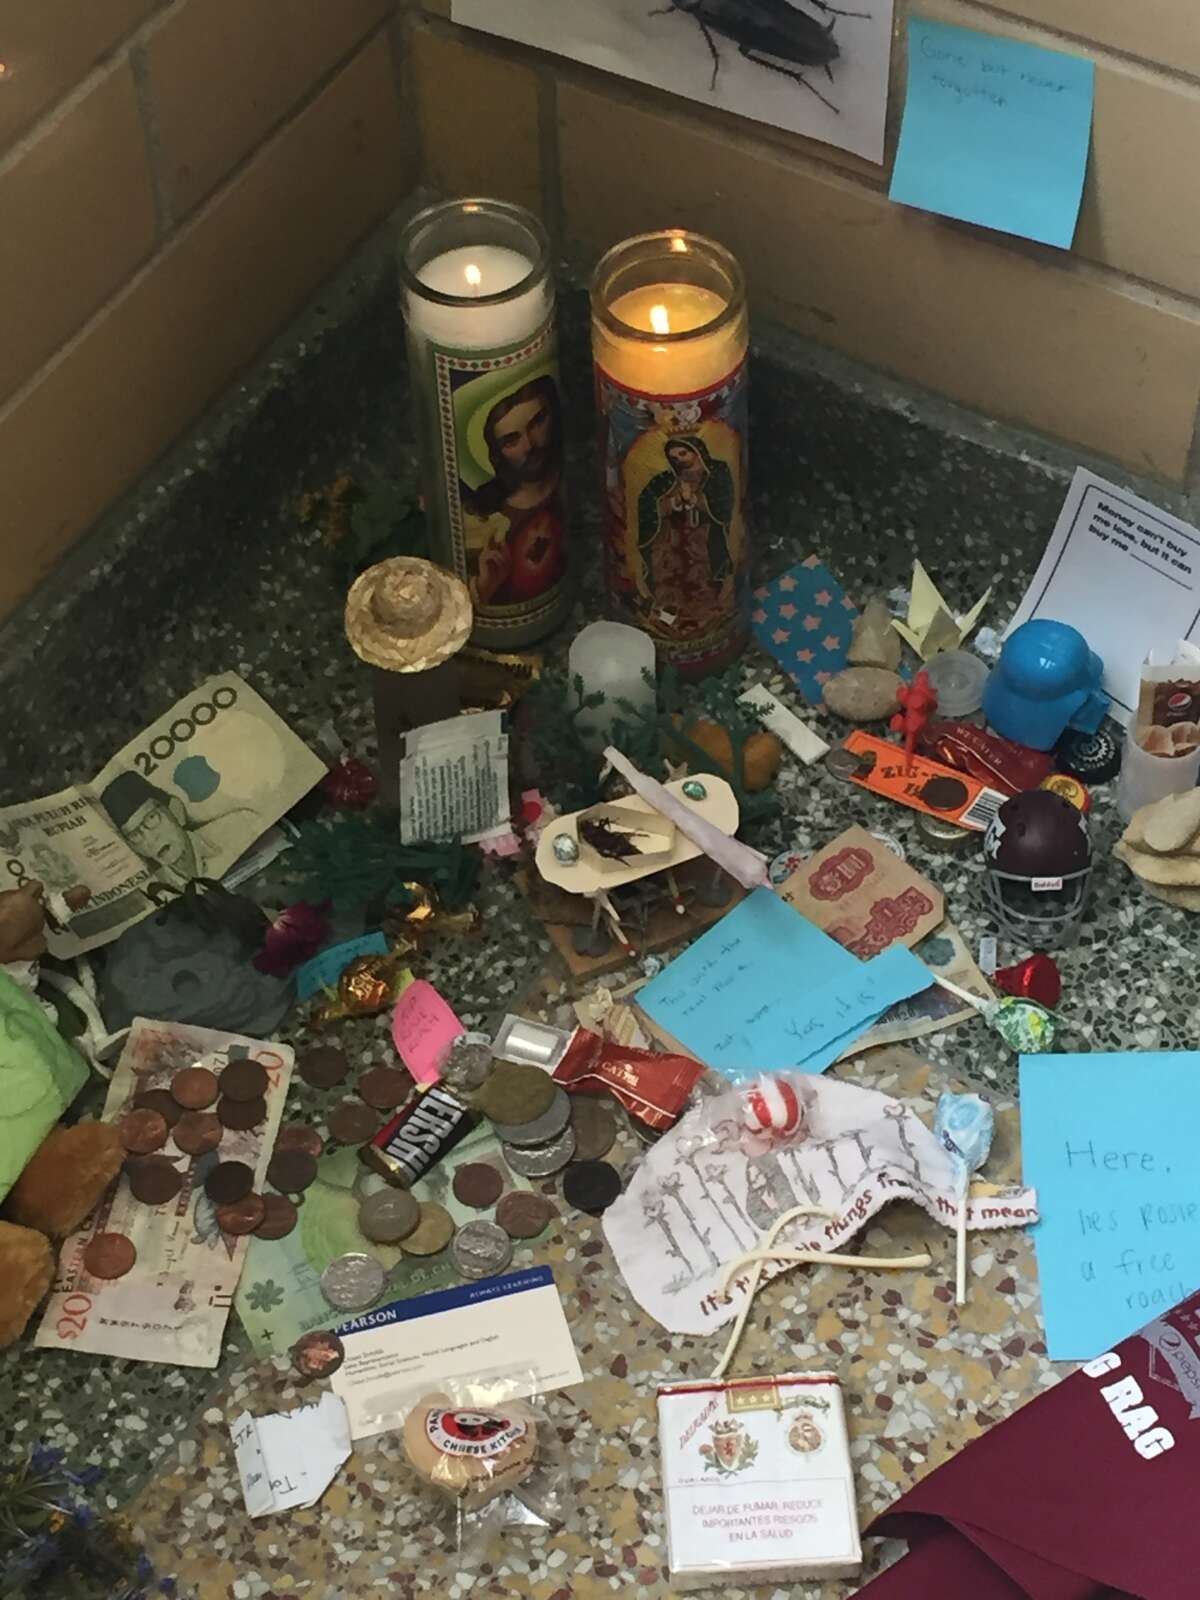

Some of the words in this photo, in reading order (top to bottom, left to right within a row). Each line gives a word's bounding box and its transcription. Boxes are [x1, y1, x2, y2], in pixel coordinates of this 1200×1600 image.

[1088, 524, 1110, 541] buy
[1111, 538, 1129, 551] me
[1093, 514, 1111, 527] me
[1113, 524, 1138, 544] love,
[1140, 539, 1160, 555] but
[1161, 551, 1169, 561] it
[1171, 558, 1192, 574] can
[1097, 502, 1135, 528] Money
[1136, 525, 1165, 544] can't
[1166, 541, 1188, 557] buy
[134, 686, 238, 777] 20000
[824, 1188, 873, 1241] things
[935, 1195, 974, 1220] tht
[981, 1206, 1038, 1221] mean
[1080, 1259, 1096, 1282] a
[1112, 1248, 1176, 1275] free
[56, 1293, 93, 1340] $20
[1100, 1375, 1176, 1461] RAG
[702, 1515, 771, 1529] IMPORTANTES
[728, 1503, 740, 1514] DE
[729, 1532, 743, 1542] EN
[745, 1531, 758, 1541] LA
[760, 1529, 793, 1540] SALUD
